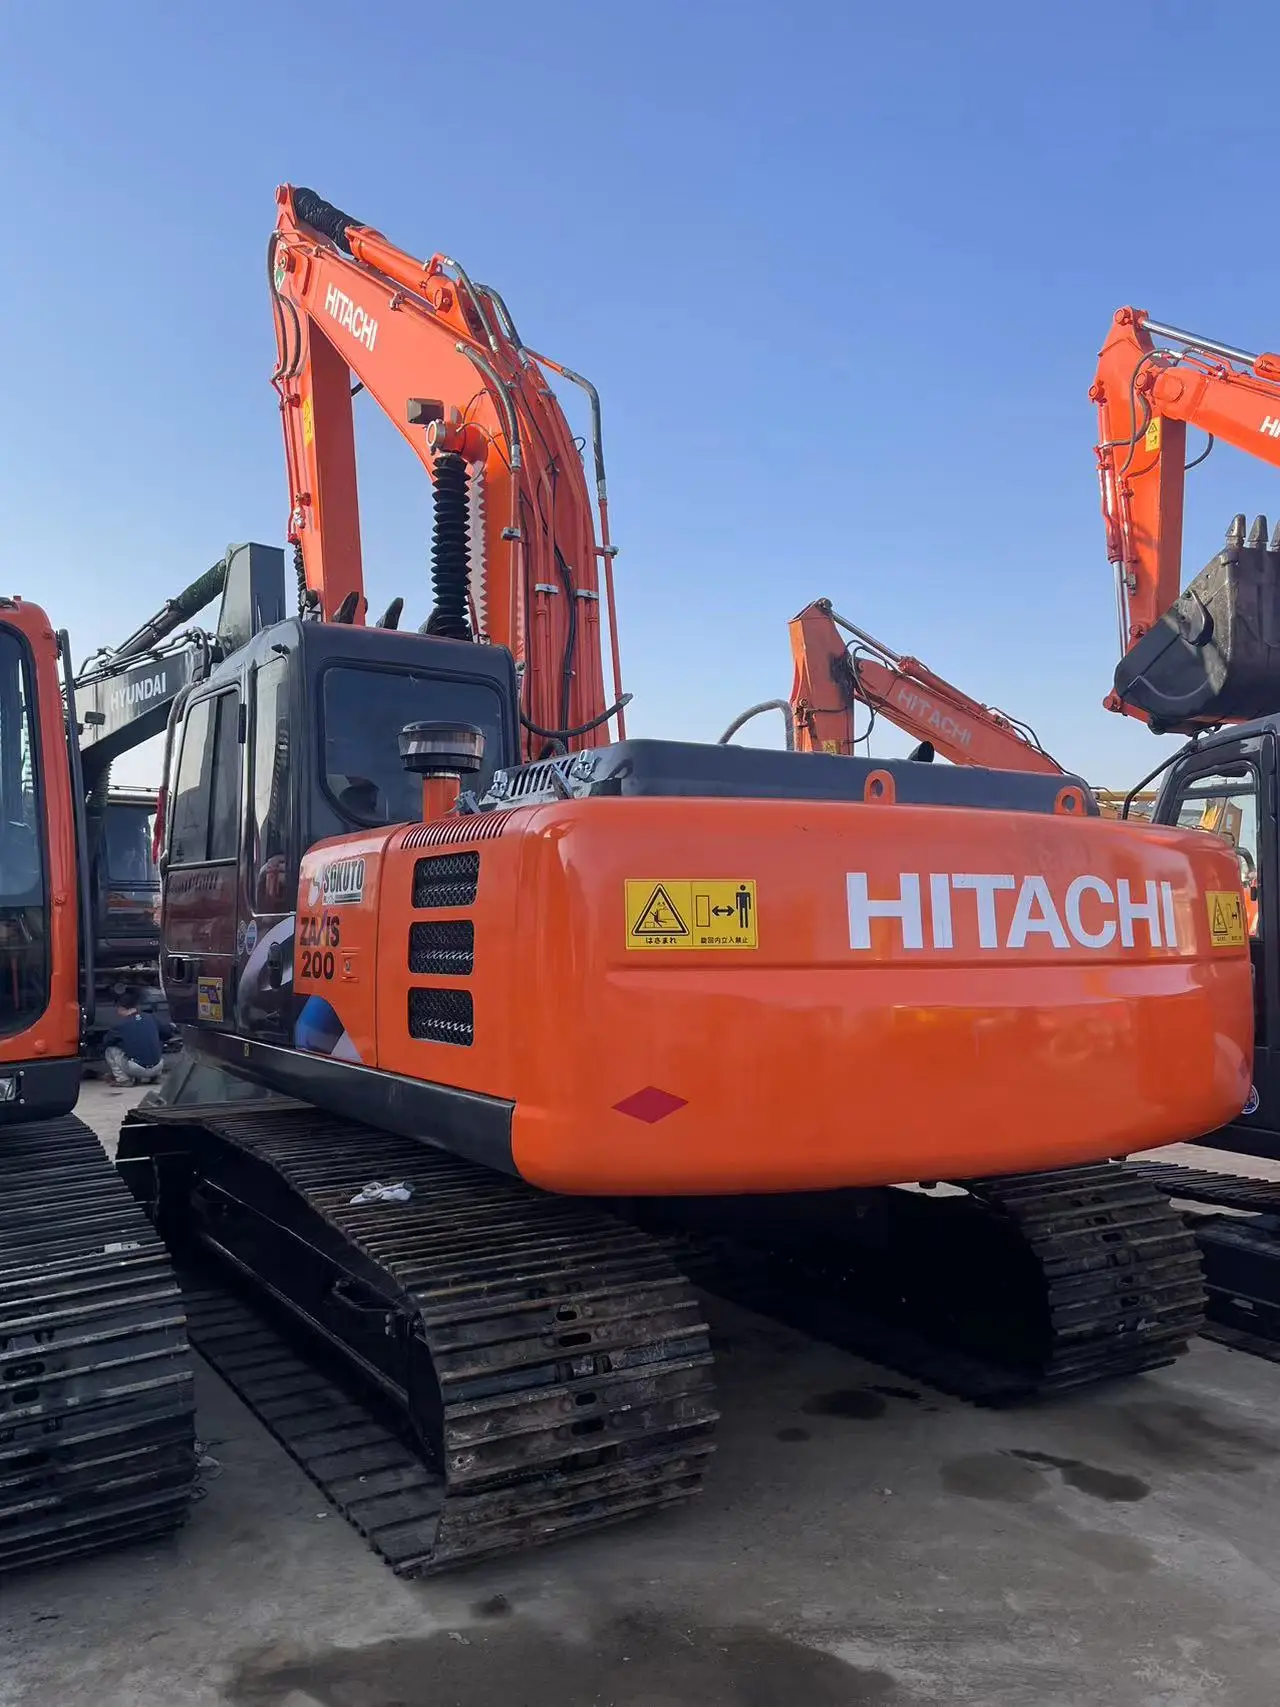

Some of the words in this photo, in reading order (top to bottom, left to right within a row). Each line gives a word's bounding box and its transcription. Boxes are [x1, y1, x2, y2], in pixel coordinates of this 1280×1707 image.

[324, 281, 379, 352] HITACHI
[110, 672, 167, 712] HYUNDAI
[897, 688, 973, 749] HITACHI
[323, 859, 364, 893] SOKUTO
[846, 872, 1177, 950] HITACHI
[645, 936, 677, 945] はさまれ
[300, 950, 335, 980] 200
